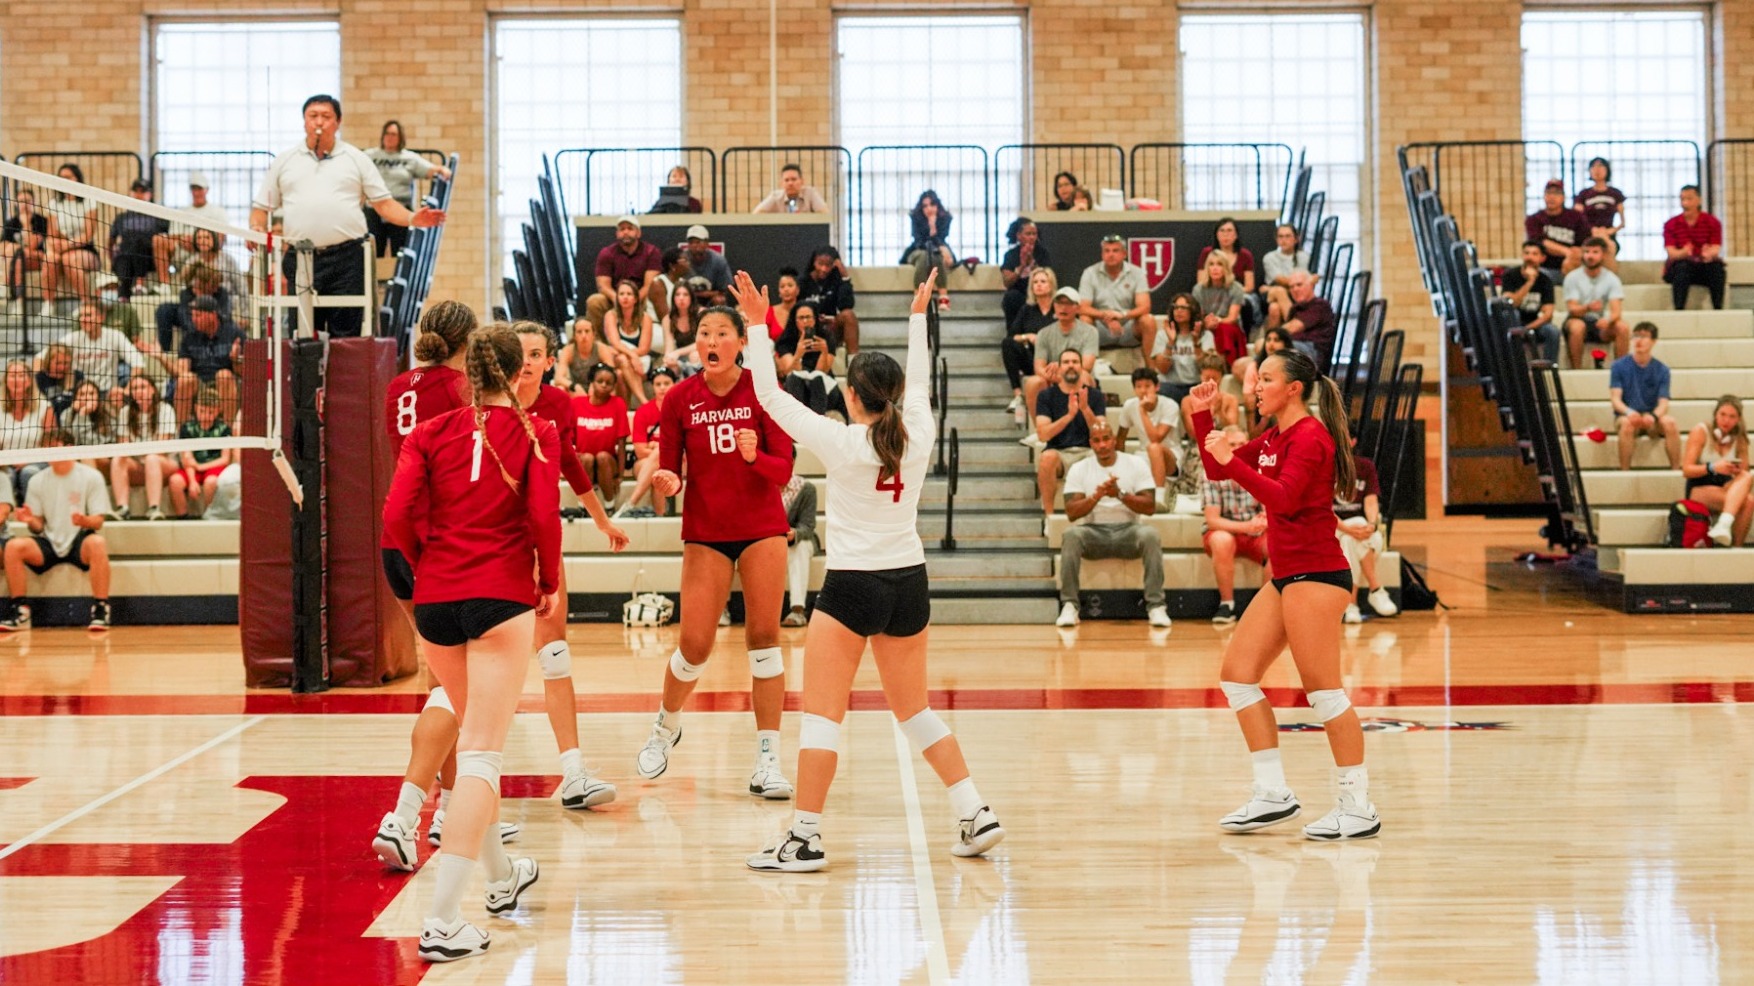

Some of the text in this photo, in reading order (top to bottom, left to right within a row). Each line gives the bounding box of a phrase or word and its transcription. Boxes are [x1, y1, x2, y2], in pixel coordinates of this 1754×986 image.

[1139, 243, 1163, 276] H
[397, 390, 418, 436] 8
[691, 407, 751, 425] HARVARD
[470, 430, 484, 482] 1
[707, 423, 736, 454] 18
[875, 464, 904, 503] 4
